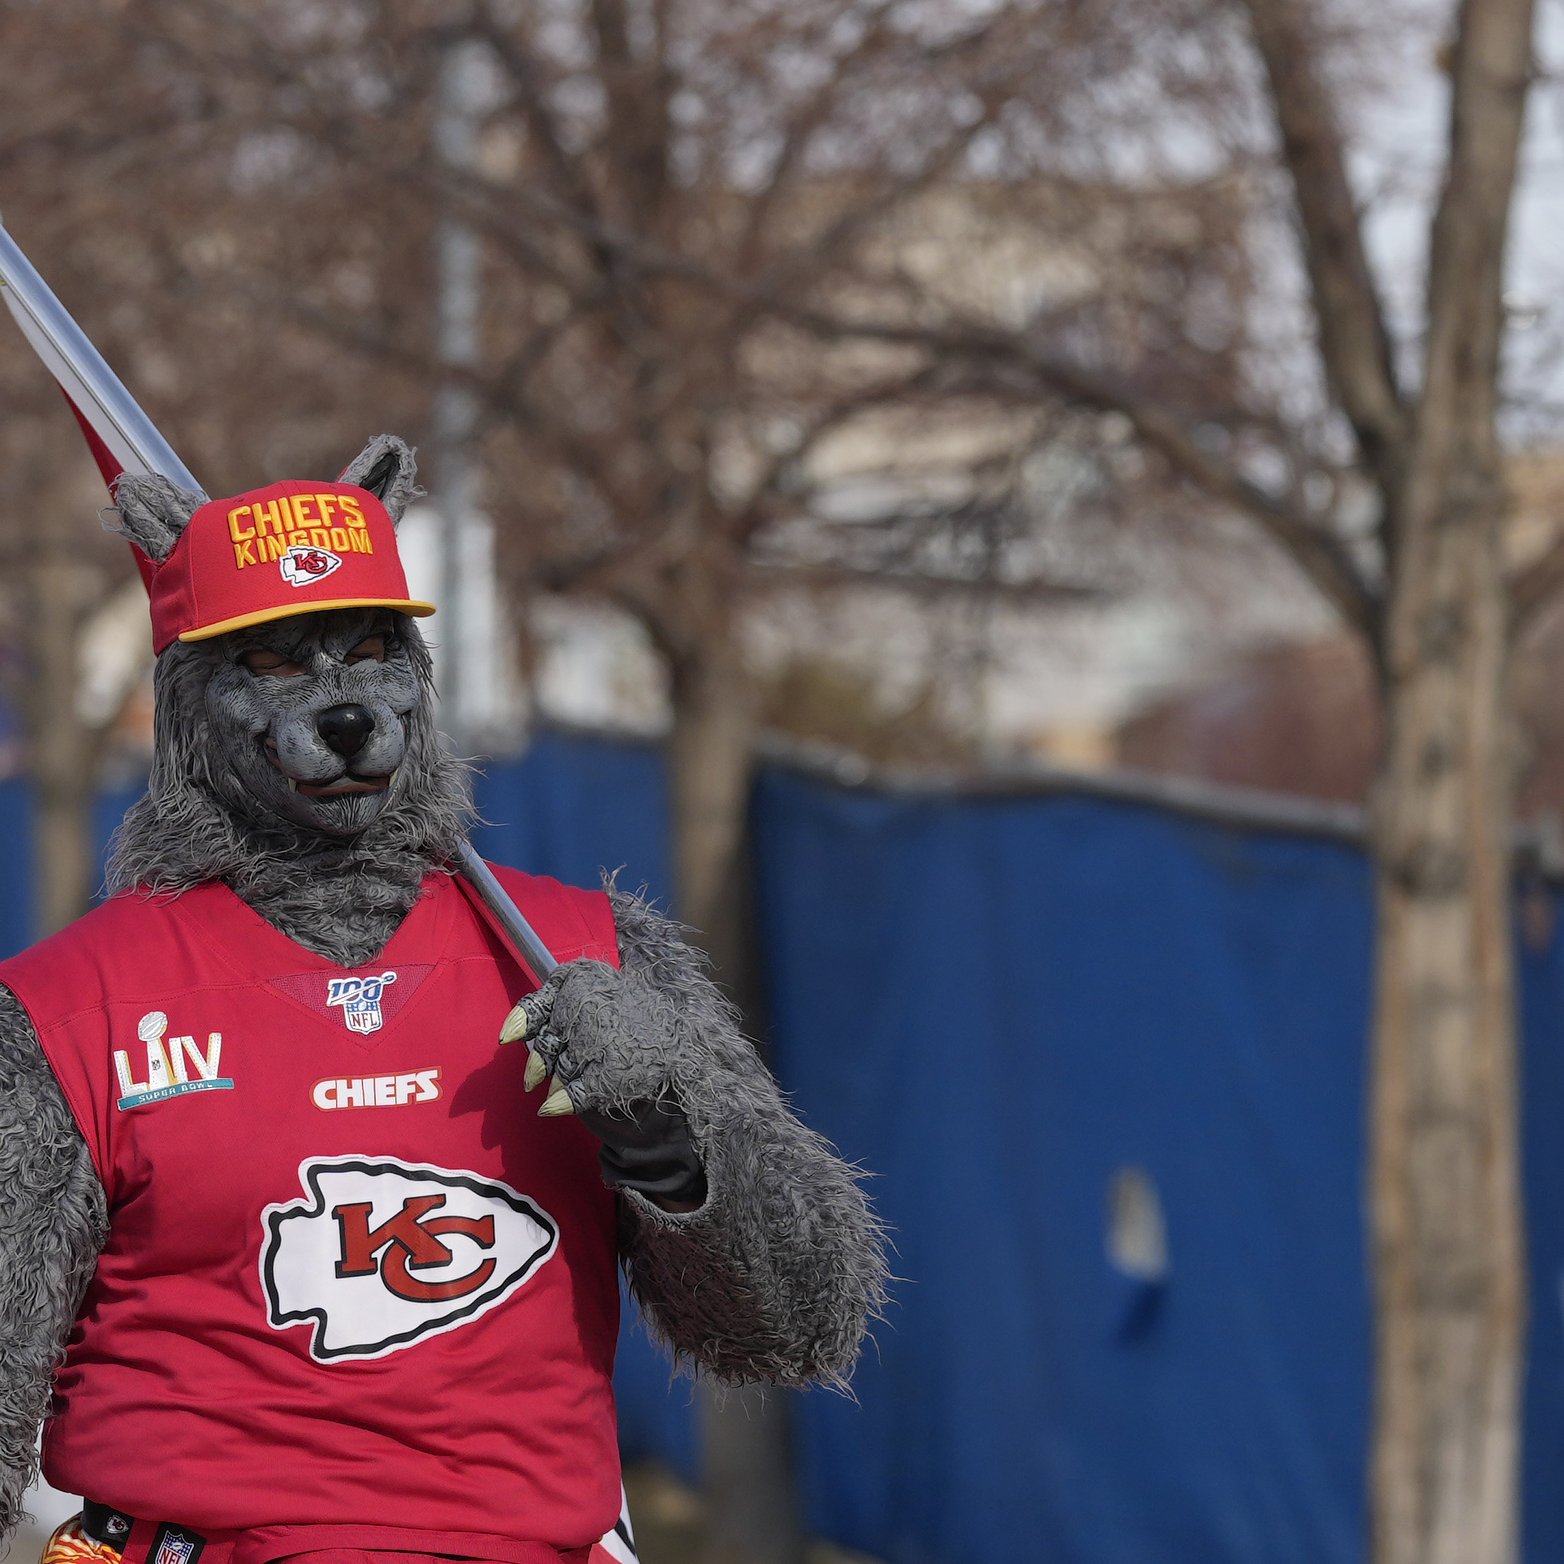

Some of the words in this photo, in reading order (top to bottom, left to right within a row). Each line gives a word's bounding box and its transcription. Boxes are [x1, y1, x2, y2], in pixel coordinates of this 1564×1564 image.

[227, 494, 367, 543] CHIEFS
[233, 527, 374, 570] KINGDOM
[294, 552, 328, 574] KC
[329, 978, 383, 1002] 100
[351, 1012, 378, 1028] NFL
[113, 1031, 223, 1099] LIV
[138, 1087, 177, 1103] SUPER
[181, 1081, 214, 1092] BOWL
[312, 1068, 440, 1109] CHIEFS
[331, 1193, 497, 1303] KC
